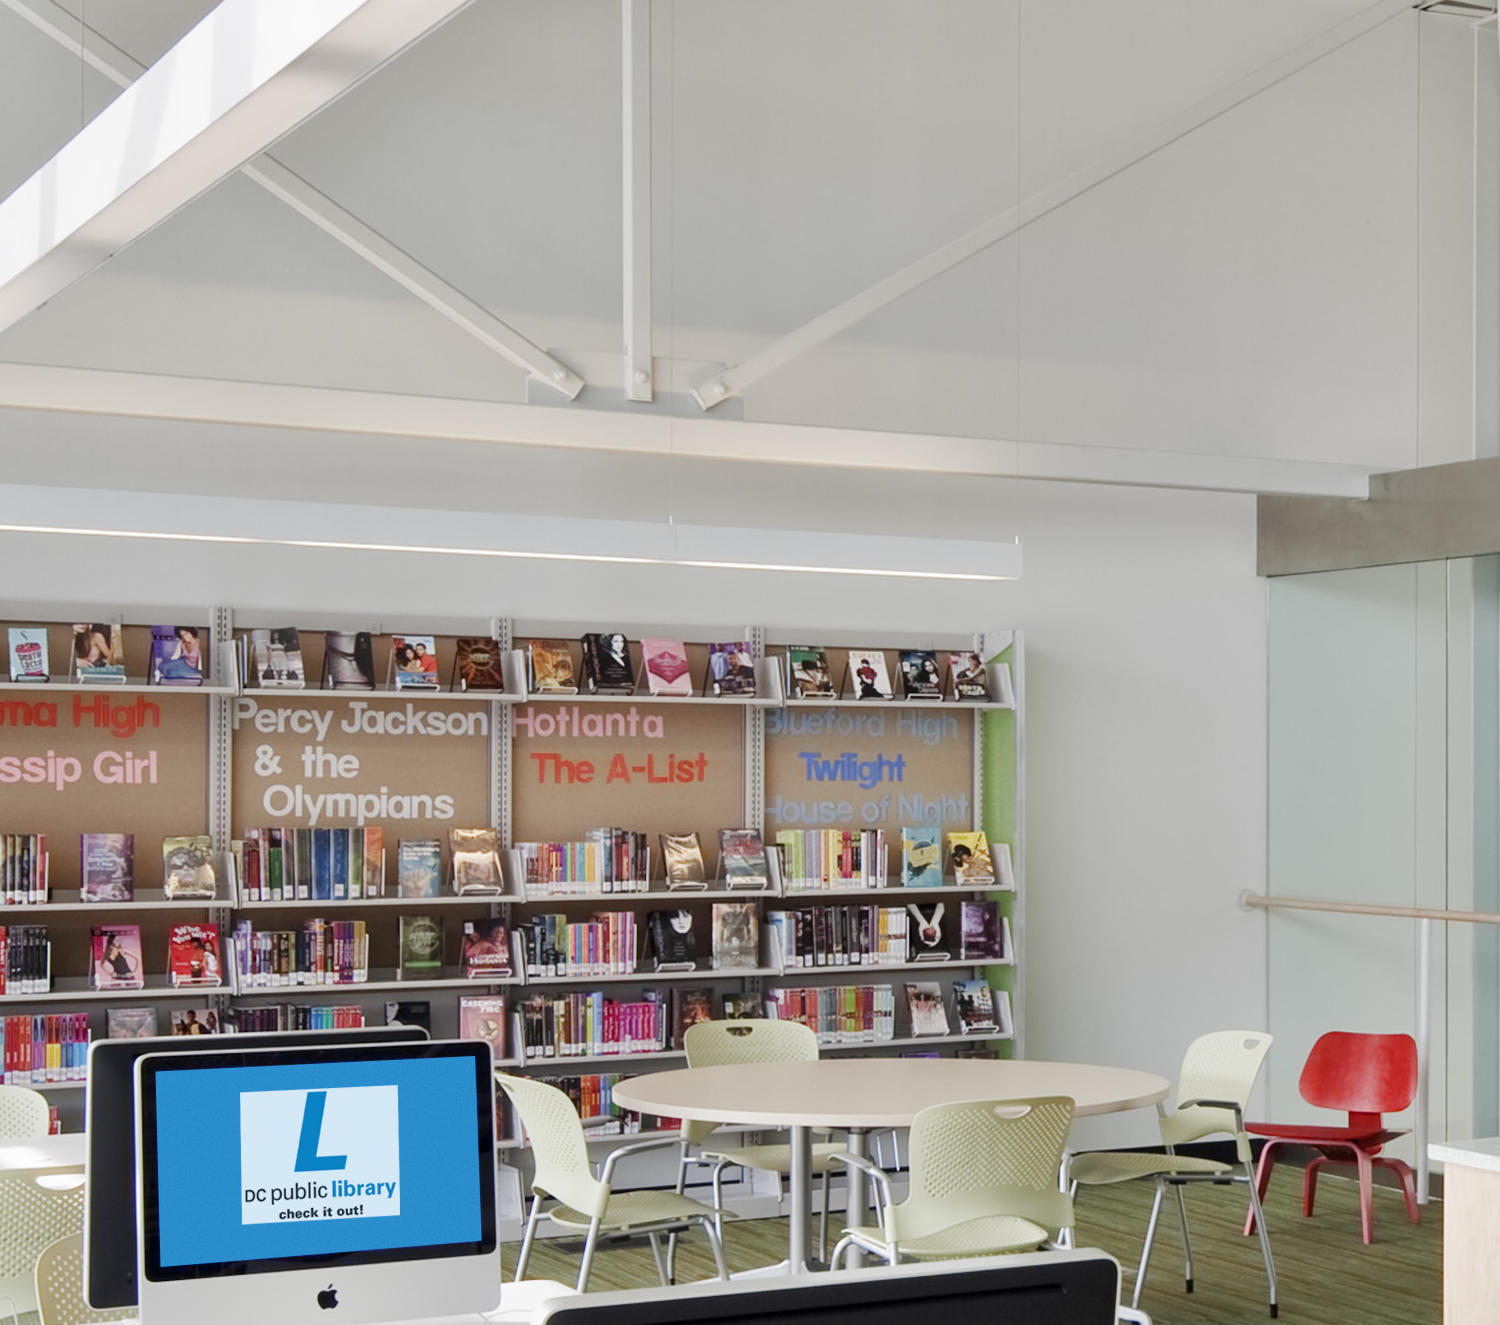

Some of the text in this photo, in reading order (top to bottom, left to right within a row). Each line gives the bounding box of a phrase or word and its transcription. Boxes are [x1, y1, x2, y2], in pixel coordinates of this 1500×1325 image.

[73, 695, 160, 738] High
[233, 699, 488, 741] Percy Jackson
[512, 707, 664, 738] Hotlanta
[766, 707, 959, 746] Blueford High
[93, 750, 157, 784] Girl
[254, 744, 359, 778] & the
[530, 752, 708, 784] The A-List
[798, 752, 905, 789] Twilight
[263, 784, 454, 826] Olympians
[764, 793, 969, 828] House of Night
[294, 1091, 348, 1172] L
[245, 1179, 396, 1205] DC public library
[279, 1205, 364, 1220] check it out!
